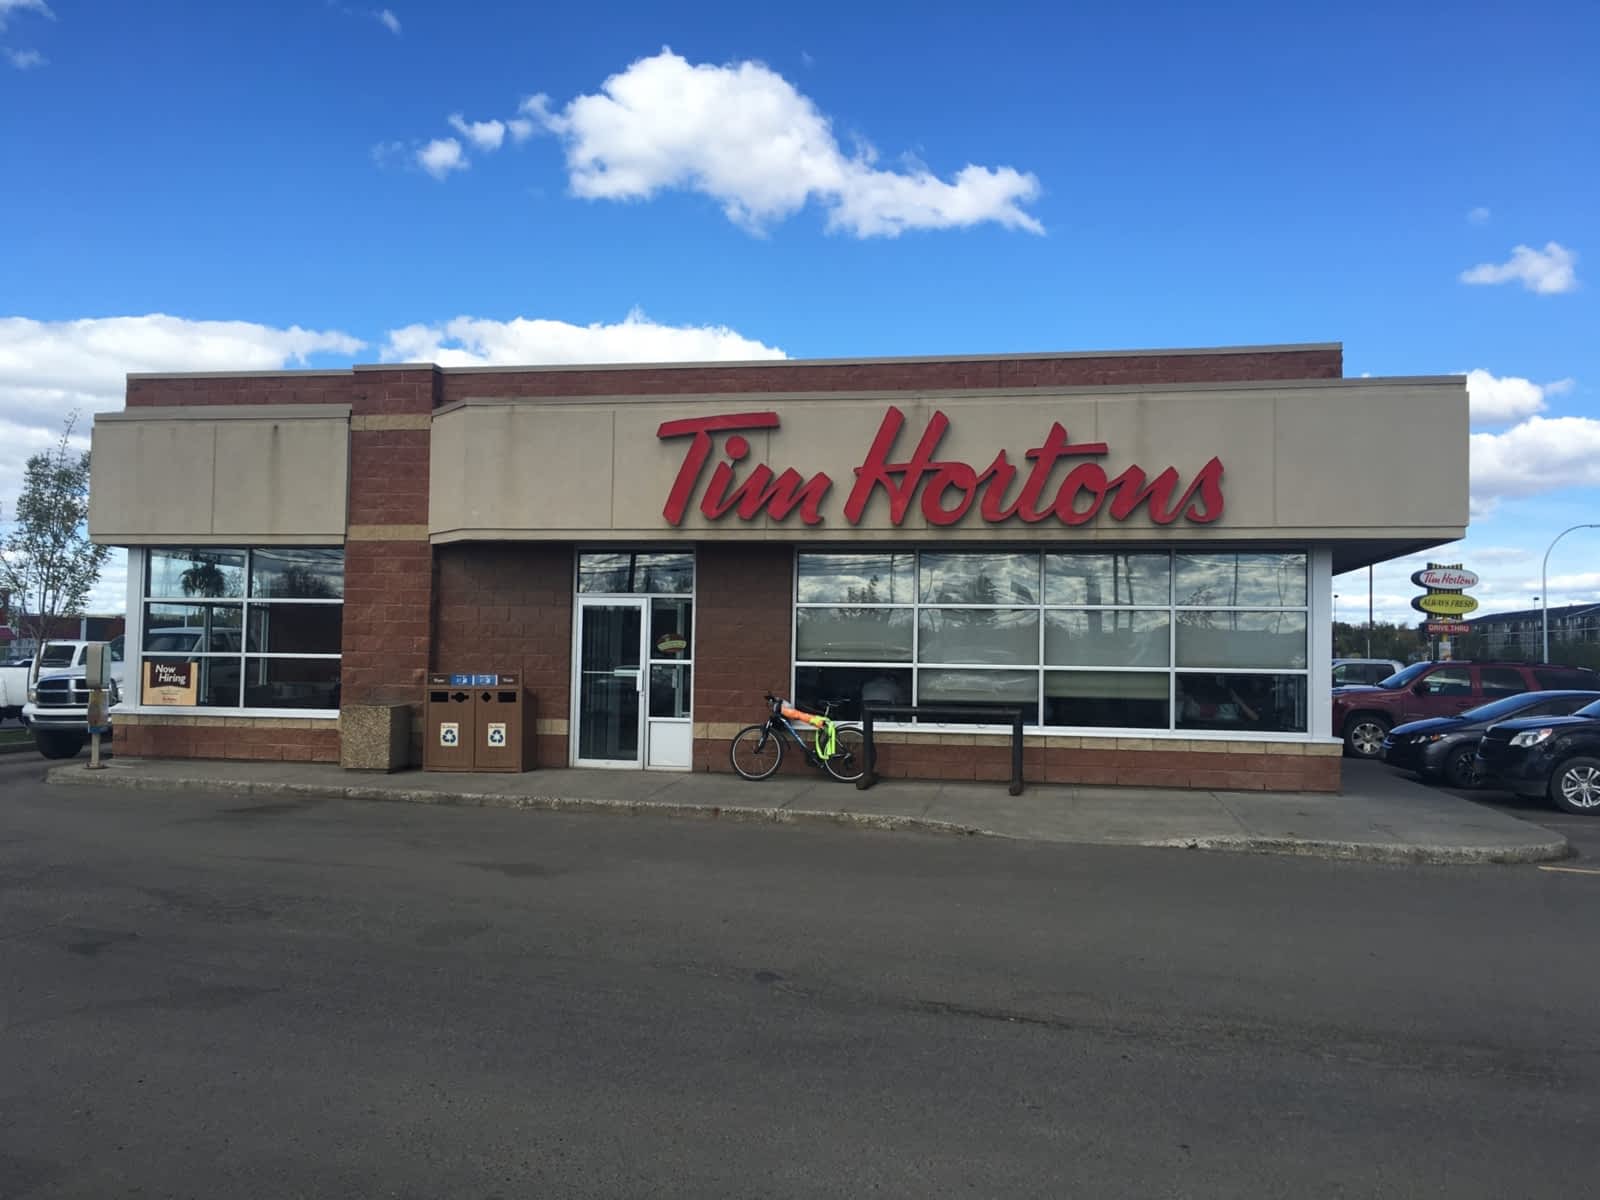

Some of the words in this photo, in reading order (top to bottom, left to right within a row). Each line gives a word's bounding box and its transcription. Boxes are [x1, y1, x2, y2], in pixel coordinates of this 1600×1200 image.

[656, 411, 833, 527] Tim
[843, 405, 1225, 526] Hortons
[1424, 572, 1441, 584] Tim
[1441, 572, 1475, 585] Hortons
[1450, 599, 1475, 608] FRESH
[155, 664, 176, 673] Now
[158, 673, 186, 685] Hiring
